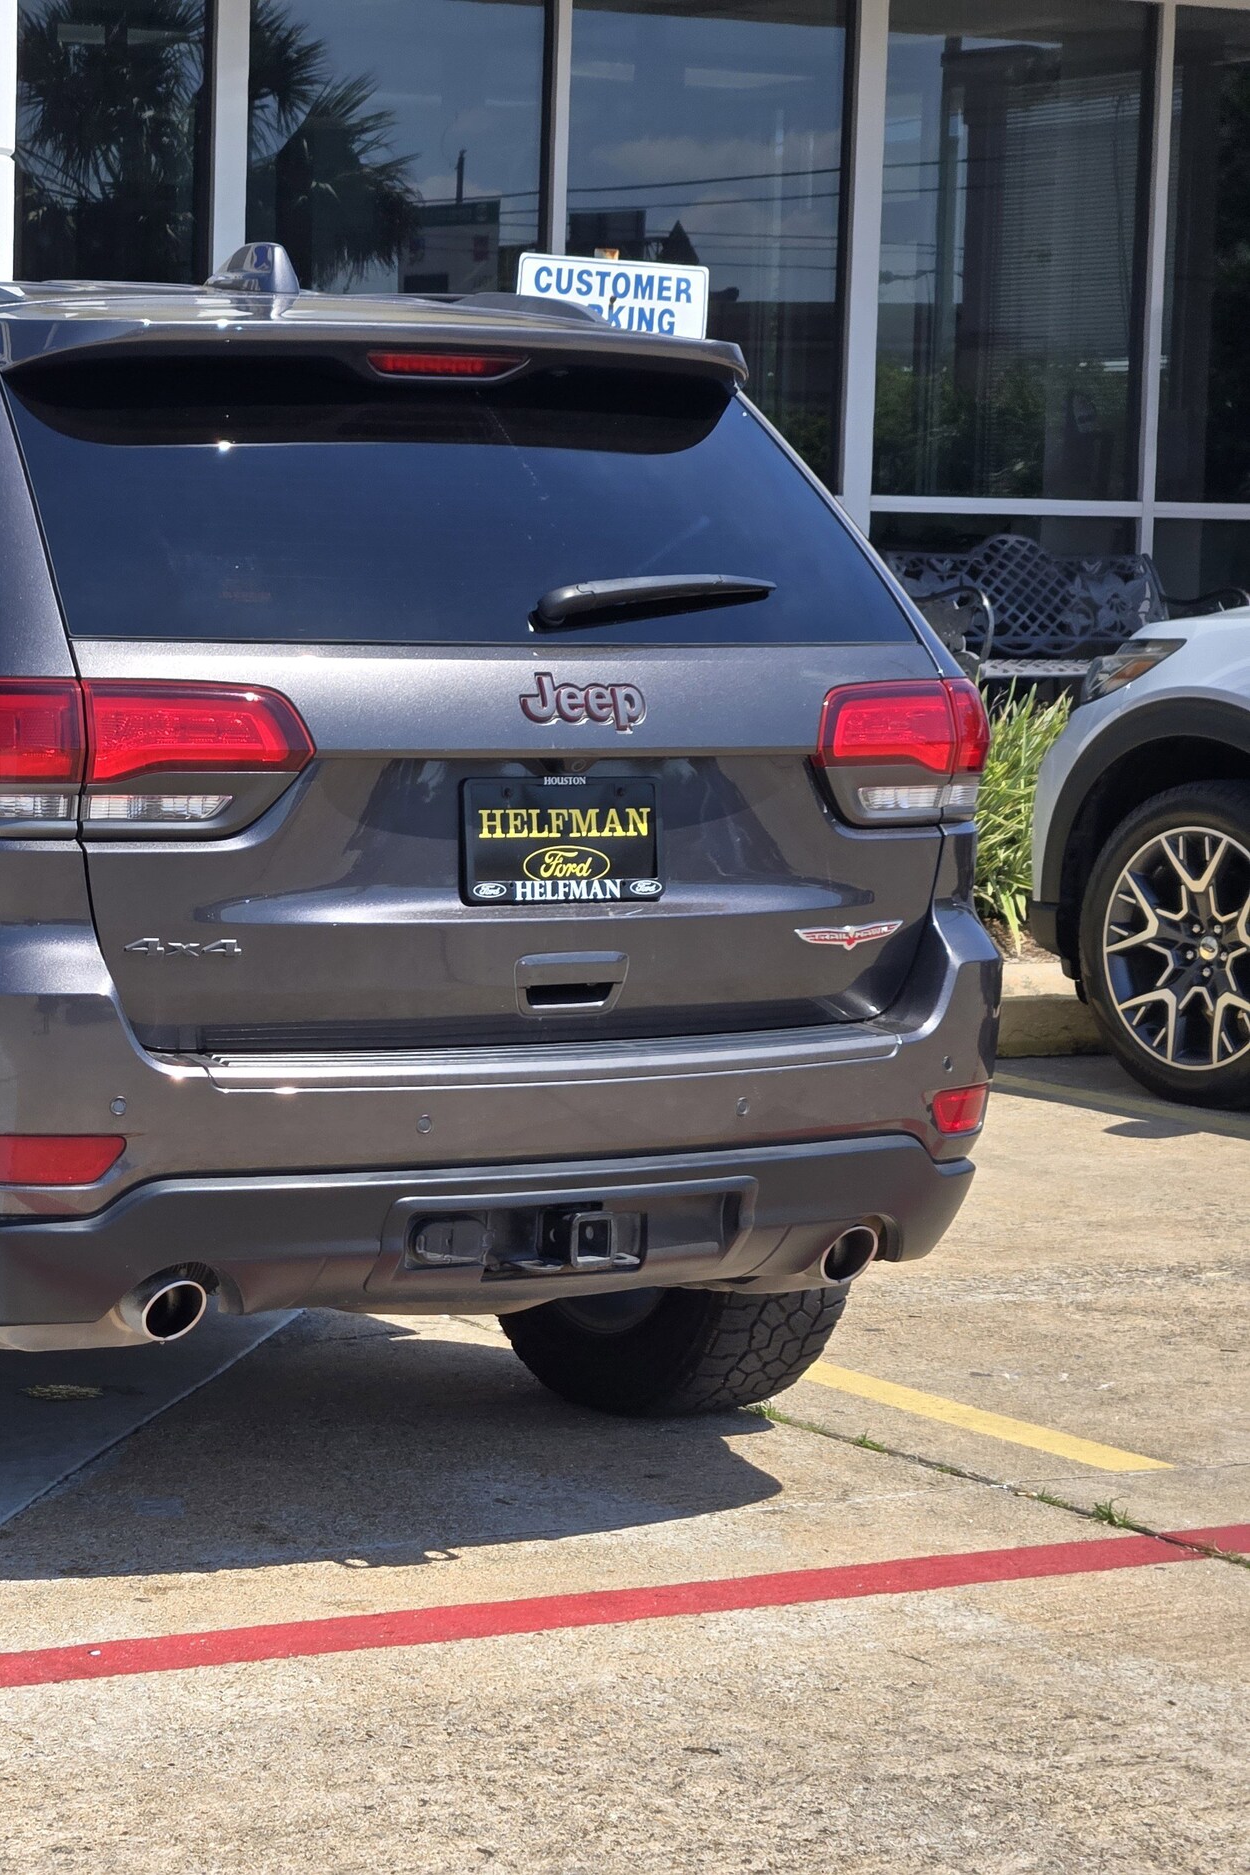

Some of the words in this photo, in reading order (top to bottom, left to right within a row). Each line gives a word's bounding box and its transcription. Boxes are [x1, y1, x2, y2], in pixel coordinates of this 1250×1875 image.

[534, 265, 693, 304] CUSTOMER
[587, 302, 676, 336] KING
[519, 671, 647, 734] Jeep
[543, 776, 587, 786] HOUSTON
[478, 808, 651, 838] HELFMAN
[540, 850, 593, 878] Ford
[514, 879, 623, 901] HELFMAN
